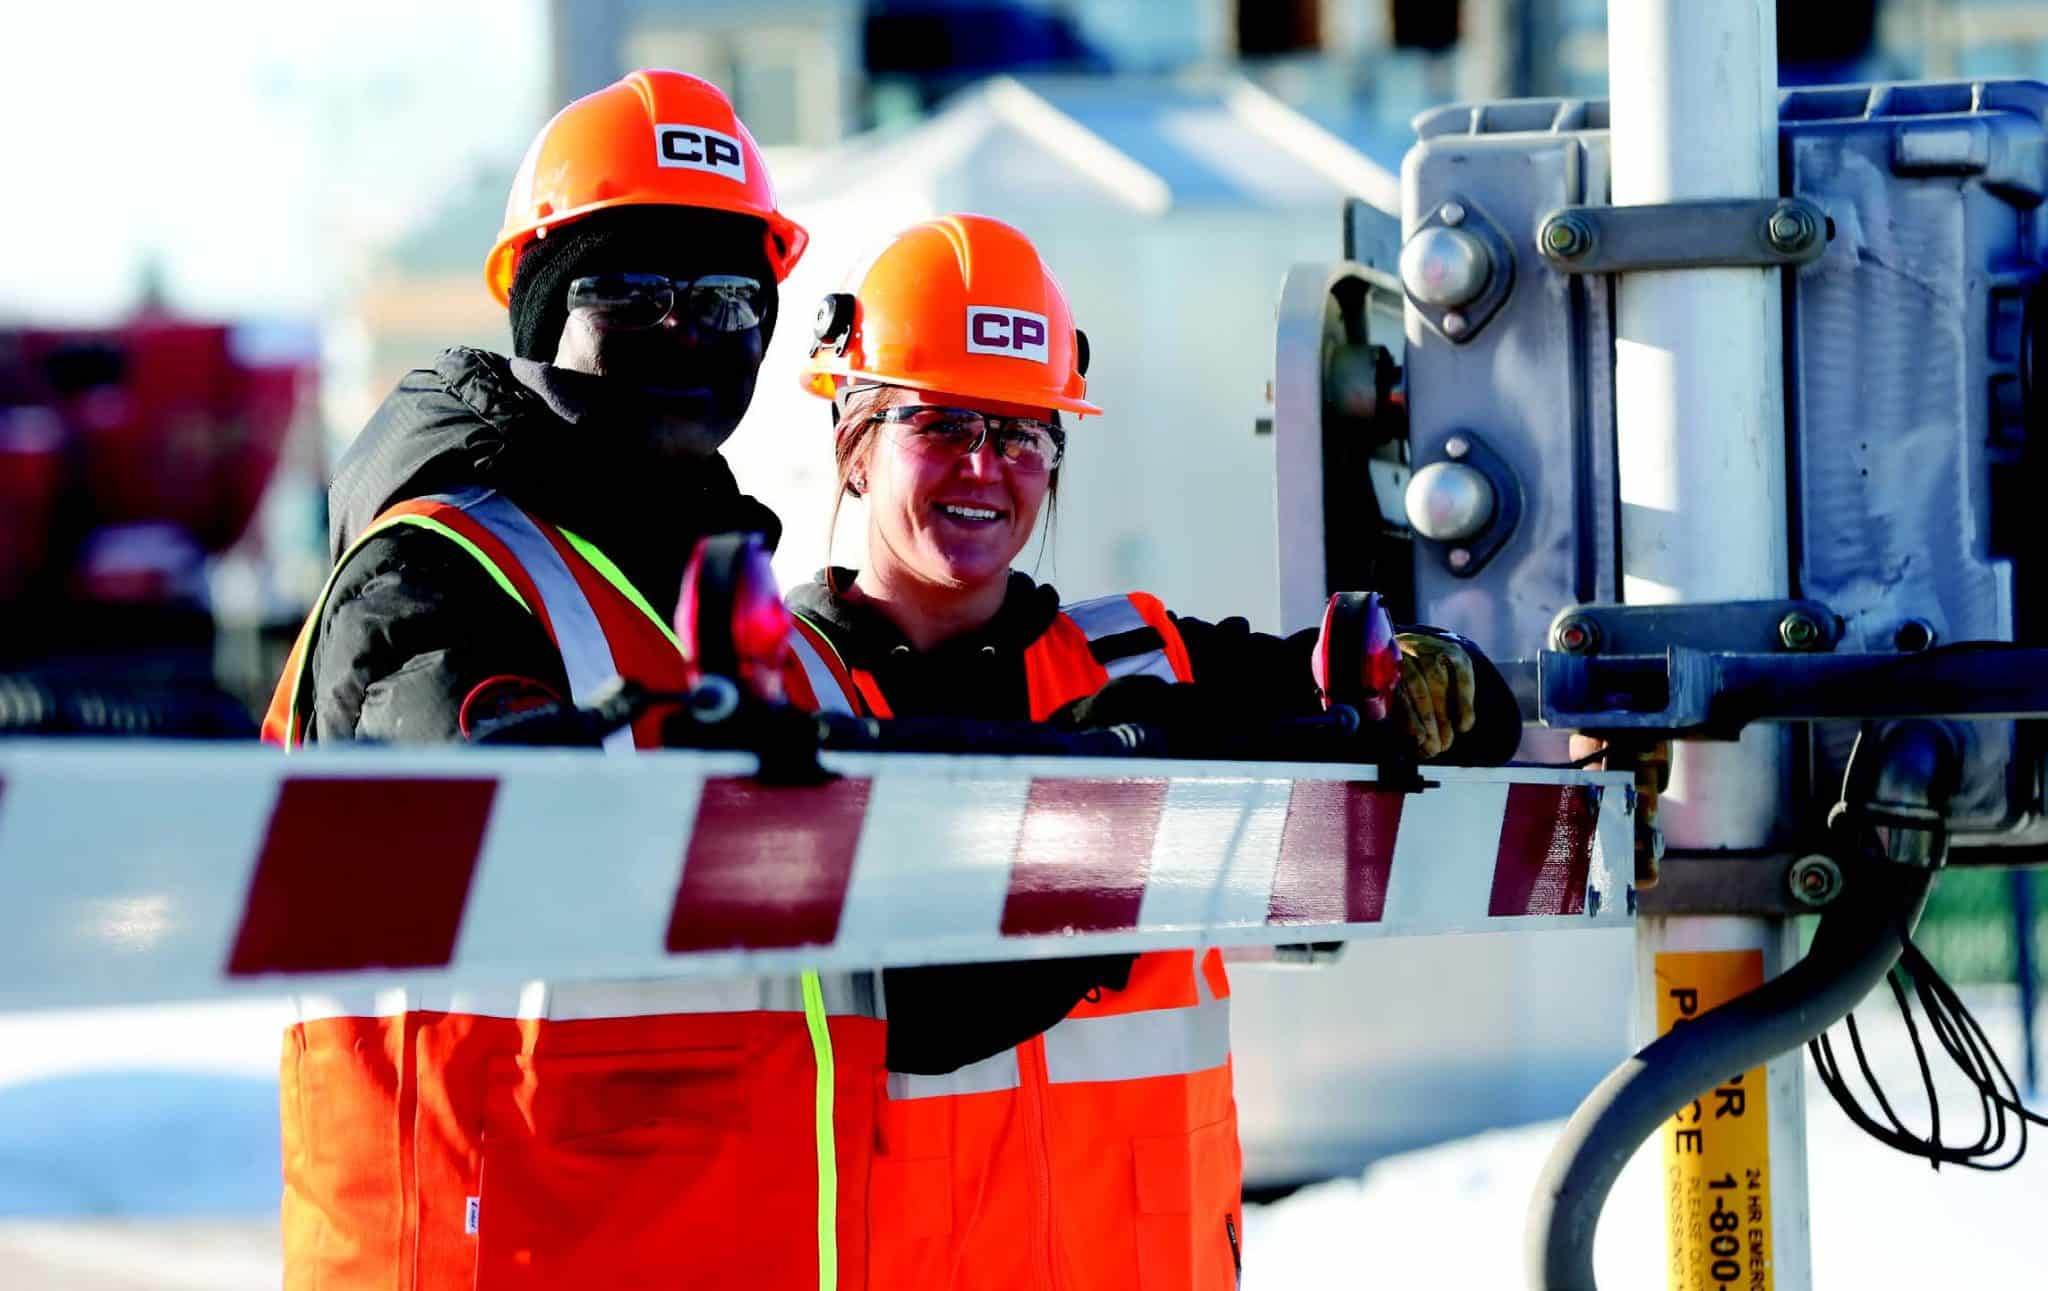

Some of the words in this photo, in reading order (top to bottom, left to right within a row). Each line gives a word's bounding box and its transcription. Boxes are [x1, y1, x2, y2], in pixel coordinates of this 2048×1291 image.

[662, 131, 740, 167] CP
[972, 312, 1045, 350] CP
[1746, 1168, 1761, 1190] 24
[1748, 1195, 1763, 1223] HR
[1689, 1246, 1705, 1291] QUO
